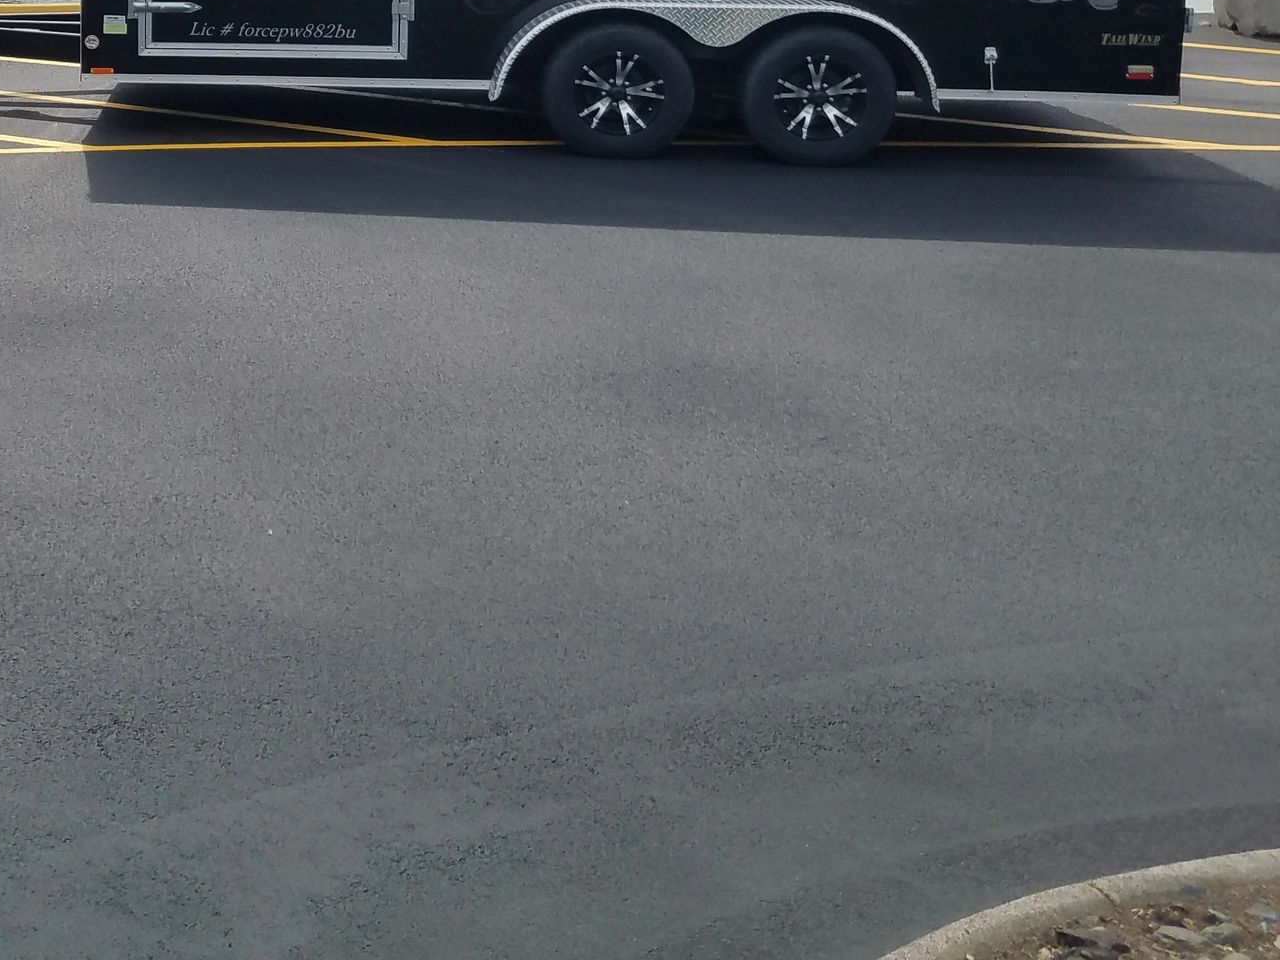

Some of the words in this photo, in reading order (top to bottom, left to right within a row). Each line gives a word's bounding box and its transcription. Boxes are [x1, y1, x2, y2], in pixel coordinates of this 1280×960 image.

[190, 21, 216, 37] Lic
[220, 22, 235, 37] #
[238, 22, 357, 43] forcepw882bu
